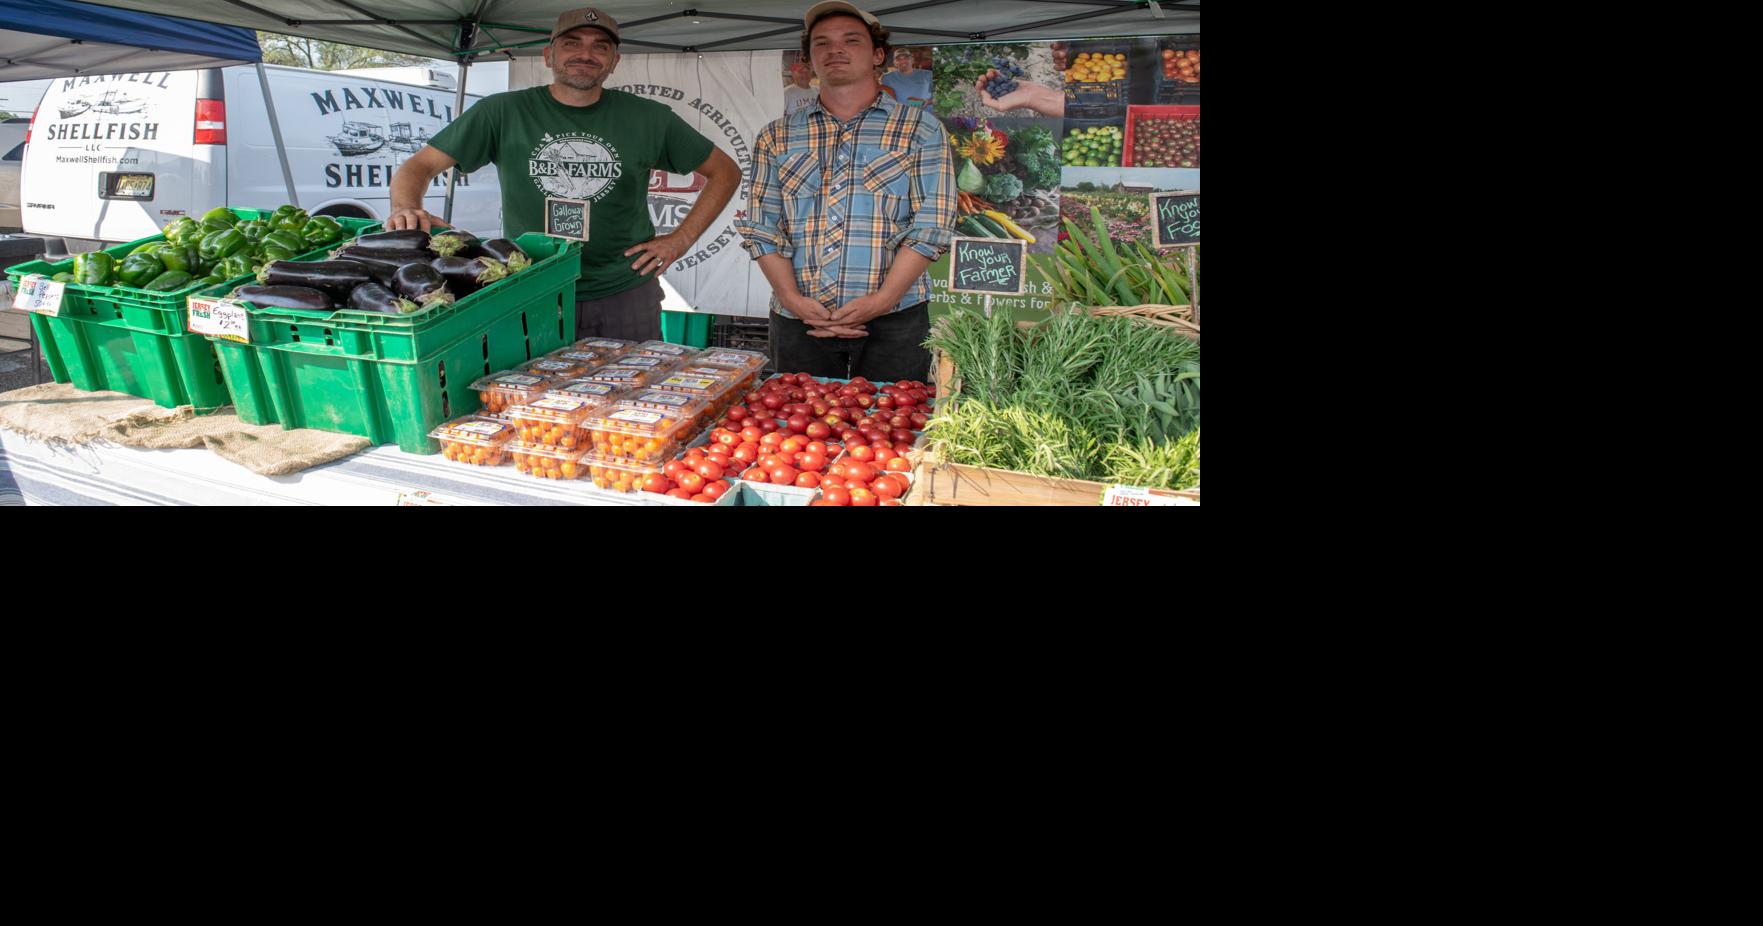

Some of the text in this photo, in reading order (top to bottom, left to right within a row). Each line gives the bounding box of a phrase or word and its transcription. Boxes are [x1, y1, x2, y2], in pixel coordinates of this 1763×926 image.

[609, 84, 685, 101] ORTED
[47, 122, 159, 141] SHELLFISH
[85, 143, 101, 152] LLC
[555, 131, 620, 159] PICK YOUR OWN
[56, 155, 139, 165] MaxwellShellfish.com
[529, 159, 622, 178] B&B FARMS
[552, 203, 585, 220] Galloway
[1158, 197, 1198, 220] Know
[554, 219, 583, 233] Grown
[674, 224, 737, 272] JERSEY
[959, 242, 994, 263] Know
[192, 301, 210, 311] JERSEY
[960, 292, 973, 305] &
[977, 293, 1026, 309] fowers
[192, 309, 210, 319] FRESH
